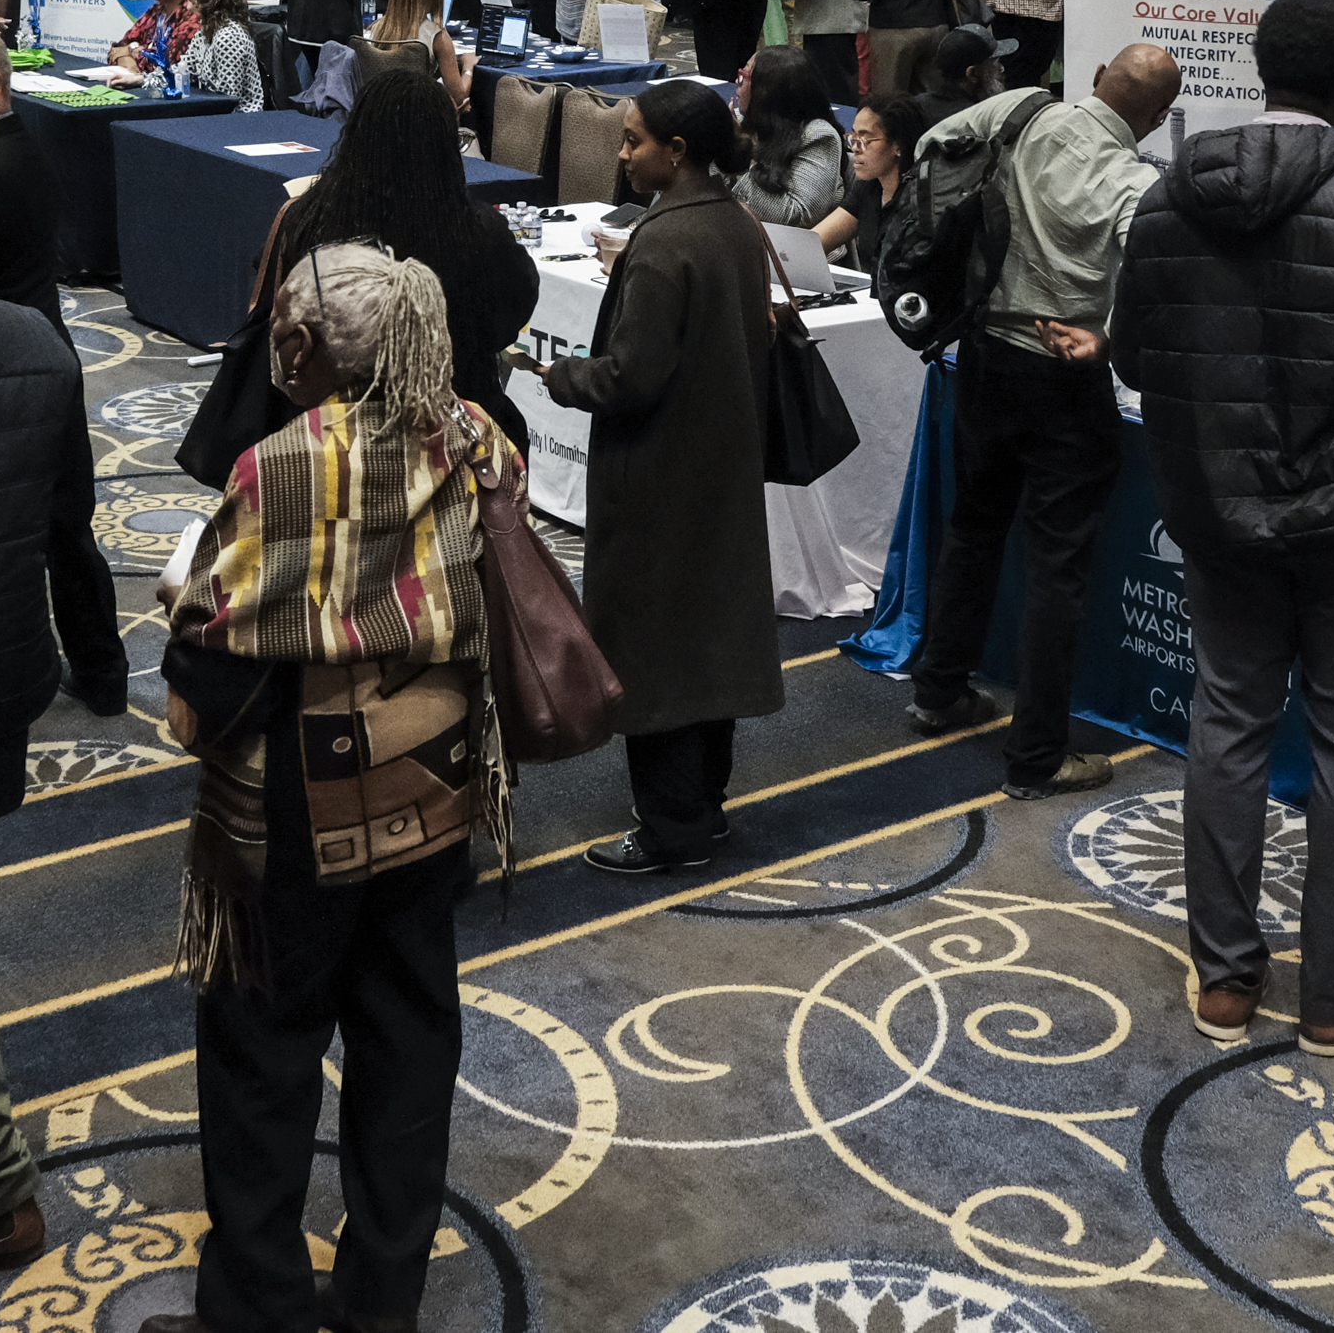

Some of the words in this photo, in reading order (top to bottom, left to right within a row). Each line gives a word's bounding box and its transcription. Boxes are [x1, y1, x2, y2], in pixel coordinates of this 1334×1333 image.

[1135, 1, 1167, 19] Our
[1172, 4, 1216, 22] Core
[1141, 26, 1197, 42] MUTUAL
[1202, 30, 1256, 46] RESPEC
[549, 437, 589, 467] Commitm
[1123, 575, 1192, 620] METRO
[1121, 602, 1192, 649] WASH
[1120, 634, 1196, 674] AIRPORTS
